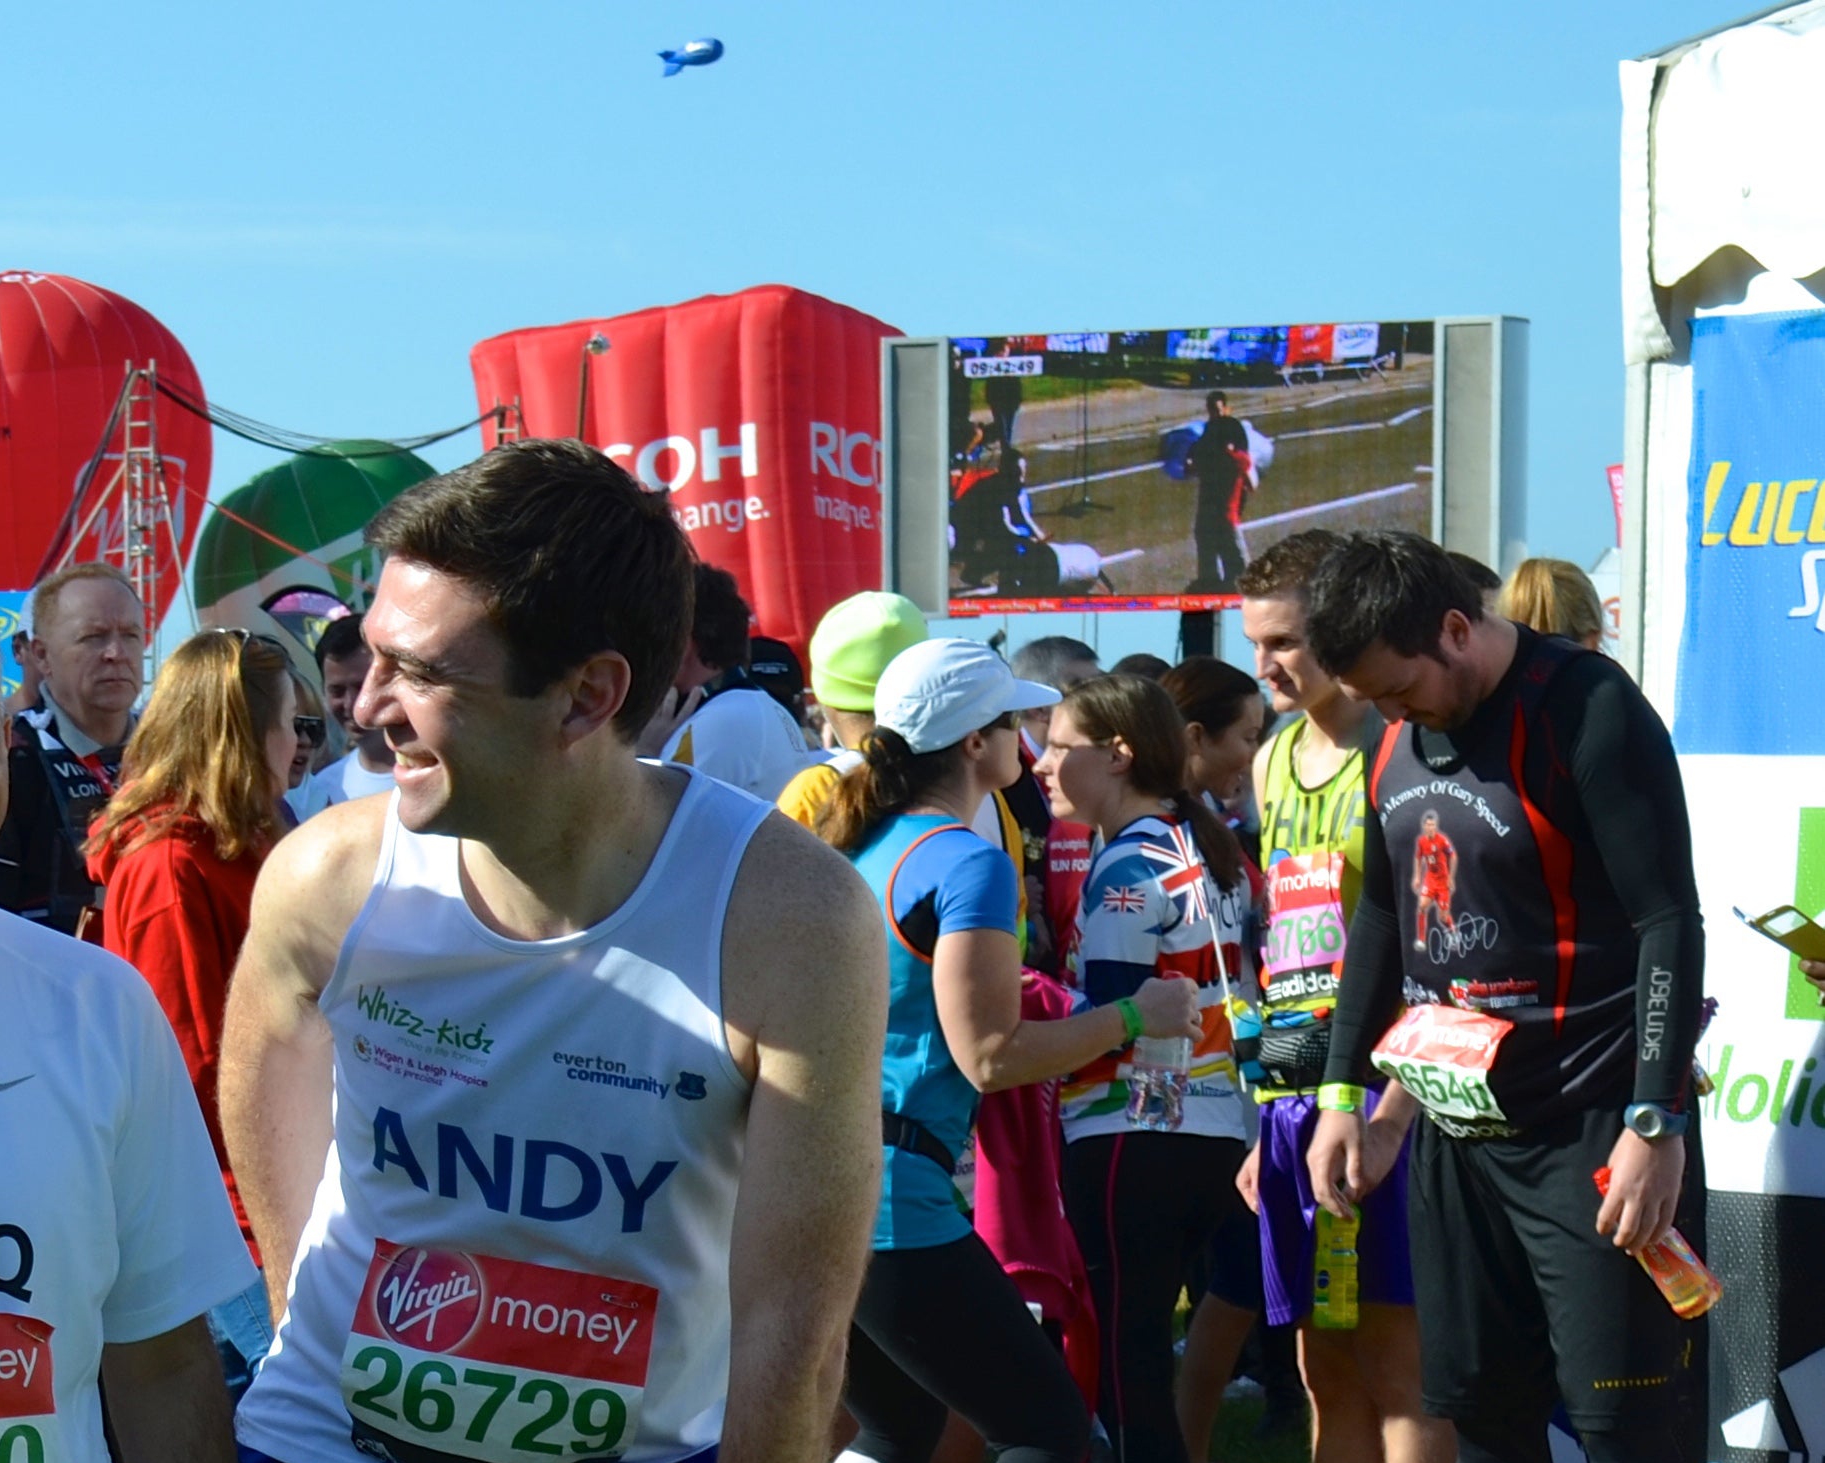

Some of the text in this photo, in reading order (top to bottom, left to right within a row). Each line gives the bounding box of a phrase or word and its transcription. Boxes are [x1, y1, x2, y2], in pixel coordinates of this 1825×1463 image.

[970, 361, 1035, 376] 09:42:49
[674, 495, 771, 533] ange.
[1385, 785, 1429, 815] Memory
[1430, 780, 1447, 795] Of
[1447, 783, 1475, 806] Gary
[1474, 796, 1511, 838] Speed
[375, 1045, 489, 1088] Wigan & Leigh Hospice
[553, 1051, 627, 1074] everton
[567, 1067, 671, 1100] community
[372, 1105, 679, 1233] ANDY
[382, 1249, 638, 1355] Virgin money
[350, 1345, 628, 1457] 26729
